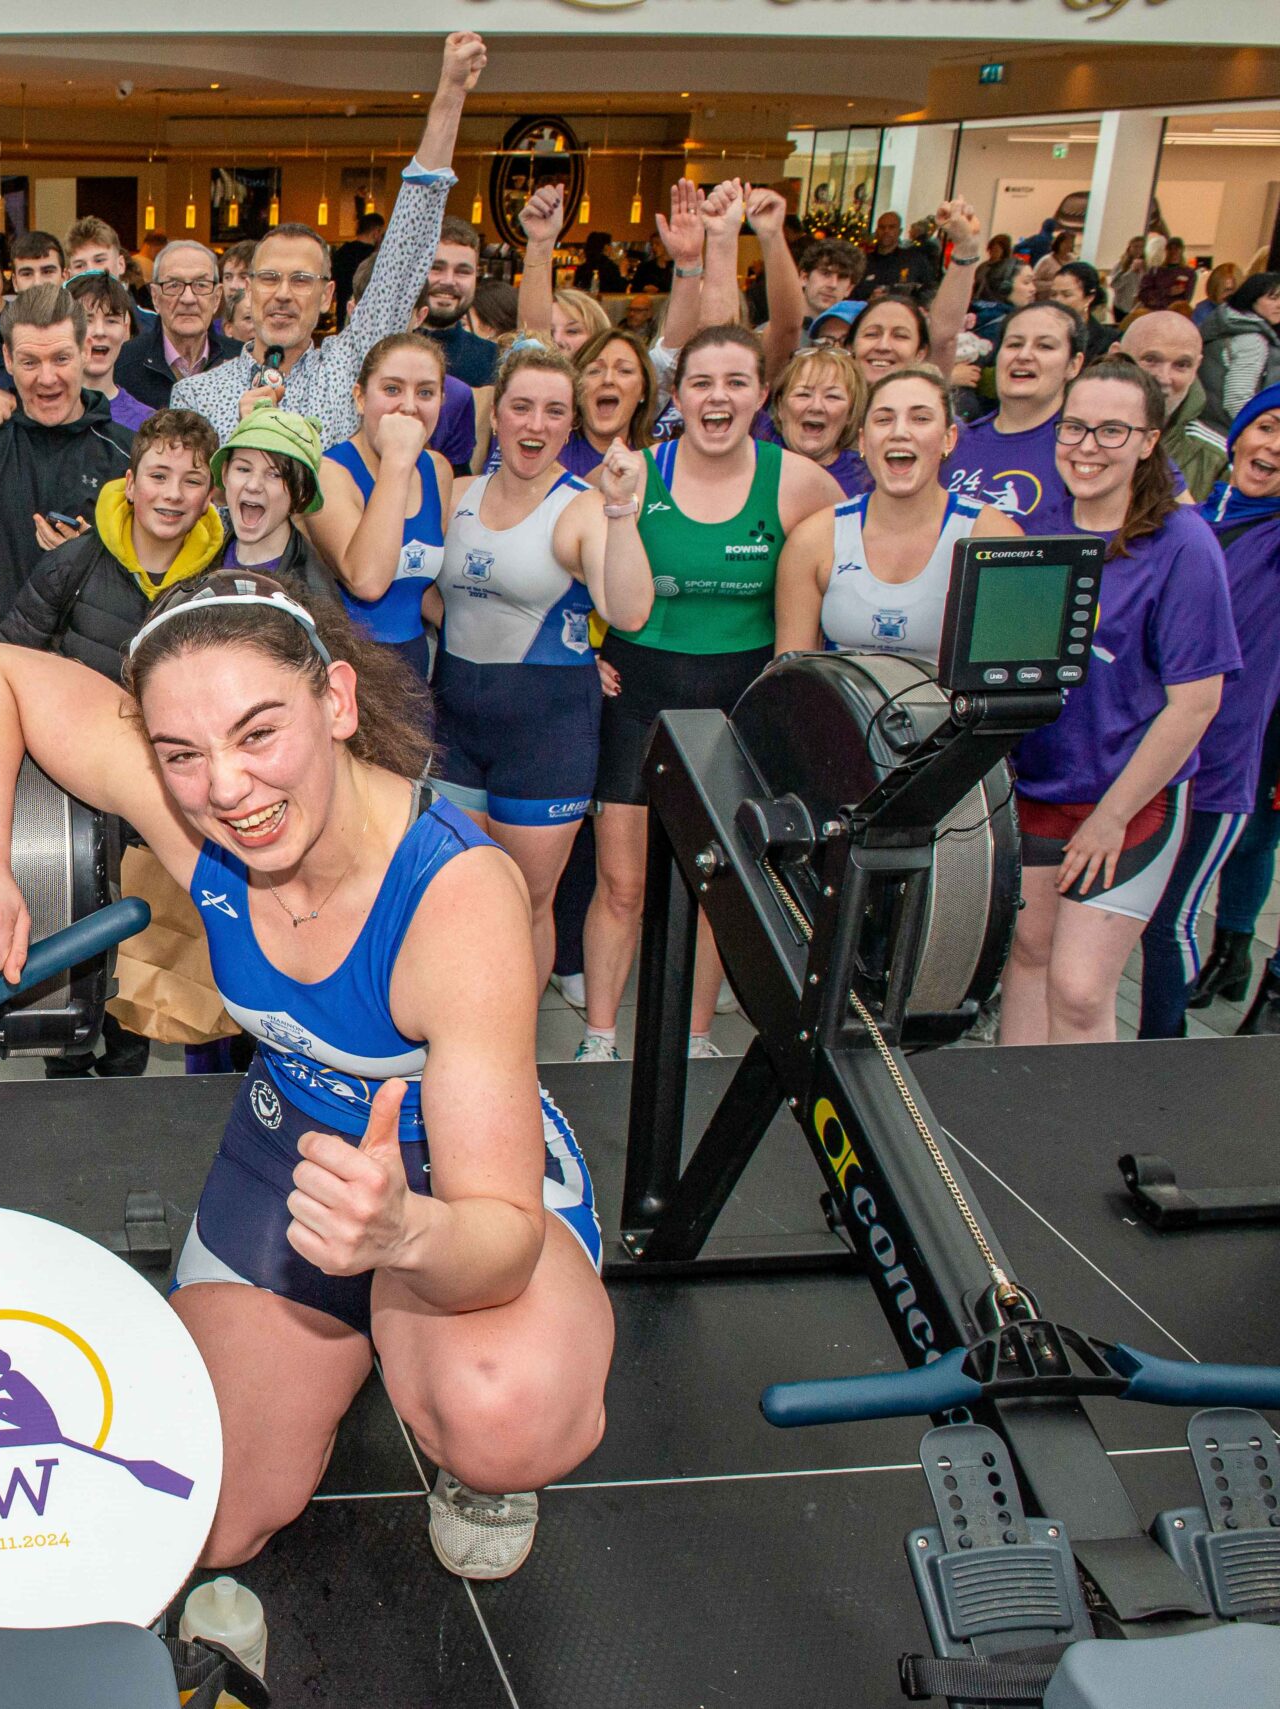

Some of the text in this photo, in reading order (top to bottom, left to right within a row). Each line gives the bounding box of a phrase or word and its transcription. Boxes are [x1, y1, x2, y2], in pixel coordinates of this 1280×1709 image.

[947, 468, 984, 493] 24
[725, 545, 769, 553] ROWING
[725, 553, 769, 561] IRELAND
[991, 550, 1034, 559] concept
[1021, 671, 1040, 680] Display
[1062, 670, 1078, 678] Menu
[266, 1014, 304, 1034] SHANNON
